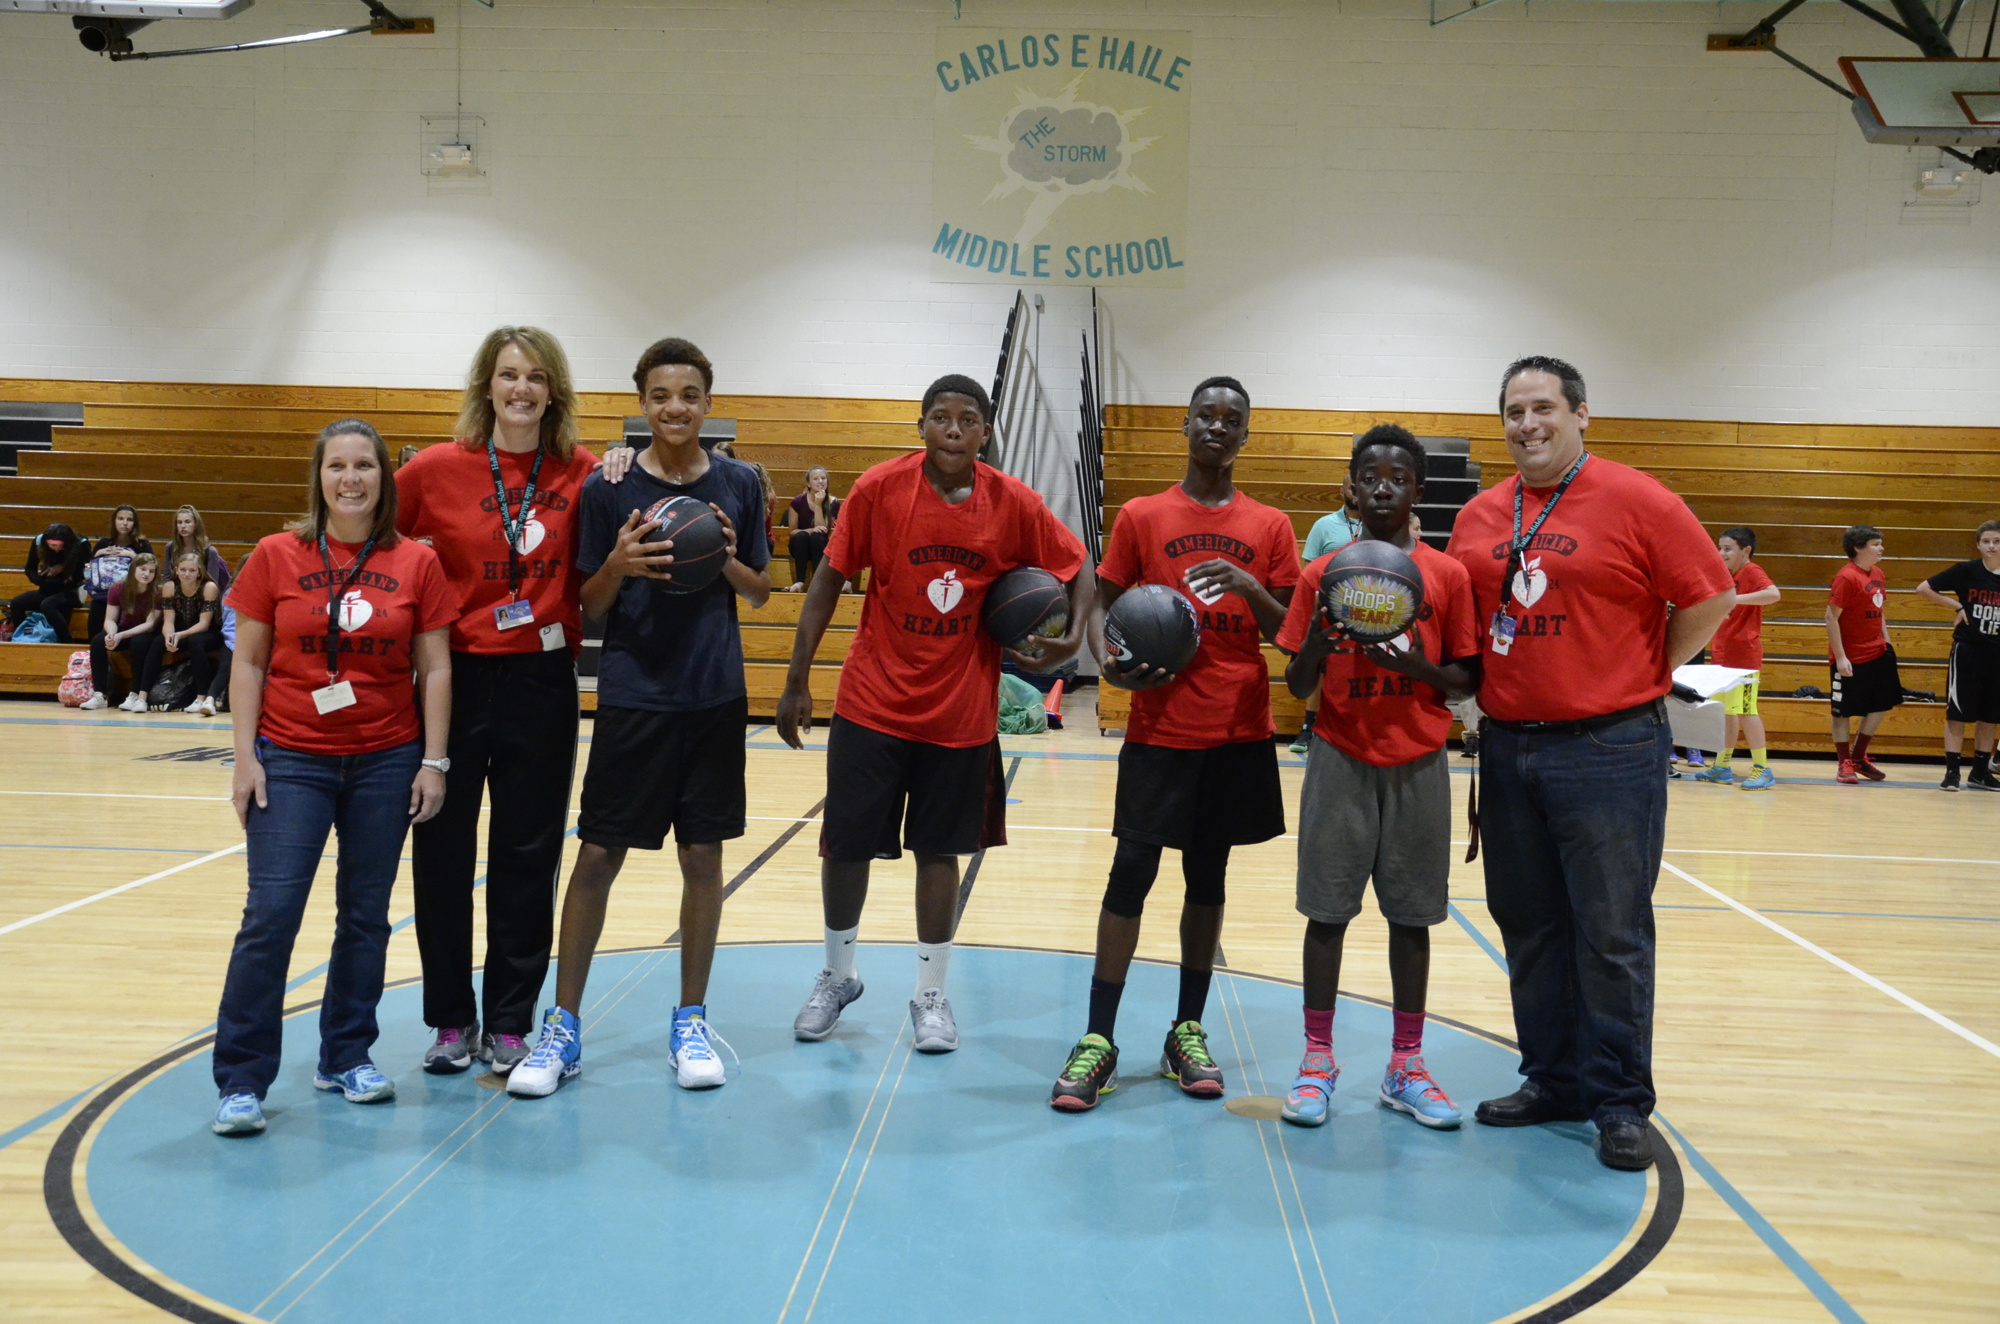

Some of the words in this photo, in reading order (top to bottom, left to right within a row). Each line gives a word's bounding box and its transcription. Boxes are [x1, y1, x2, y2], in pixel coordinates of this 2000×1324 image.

[936, 33, 1060, 93] CARLOS
[1071, 34, 1090, 68] E
[1098, 36, 1191, 92] HAILE
[1019, 116, 1056, 149] THE
[1044, 145, 1106, 162] STORM
[932, 222, 1051, 278] MIDDLE
[1064, 236, 1184, 278] SCHOOL
[1527, 513, 1548, 536] Middle
[1542, 491, 1562, 515] School
[918, 546, 982, 570] AMERICAN
[1174, 535, 1249, 559] AMERICAN
[311, 606, 324, 616] 19
[1343, 588, 1396, 611] HOOPS
[902, 612, 973, 637] HEART
[1200, 610, 1244, 634] ART
[1348, 605, 1395, 625] HEART
[1347, 674, 1415, 699] HEAR
